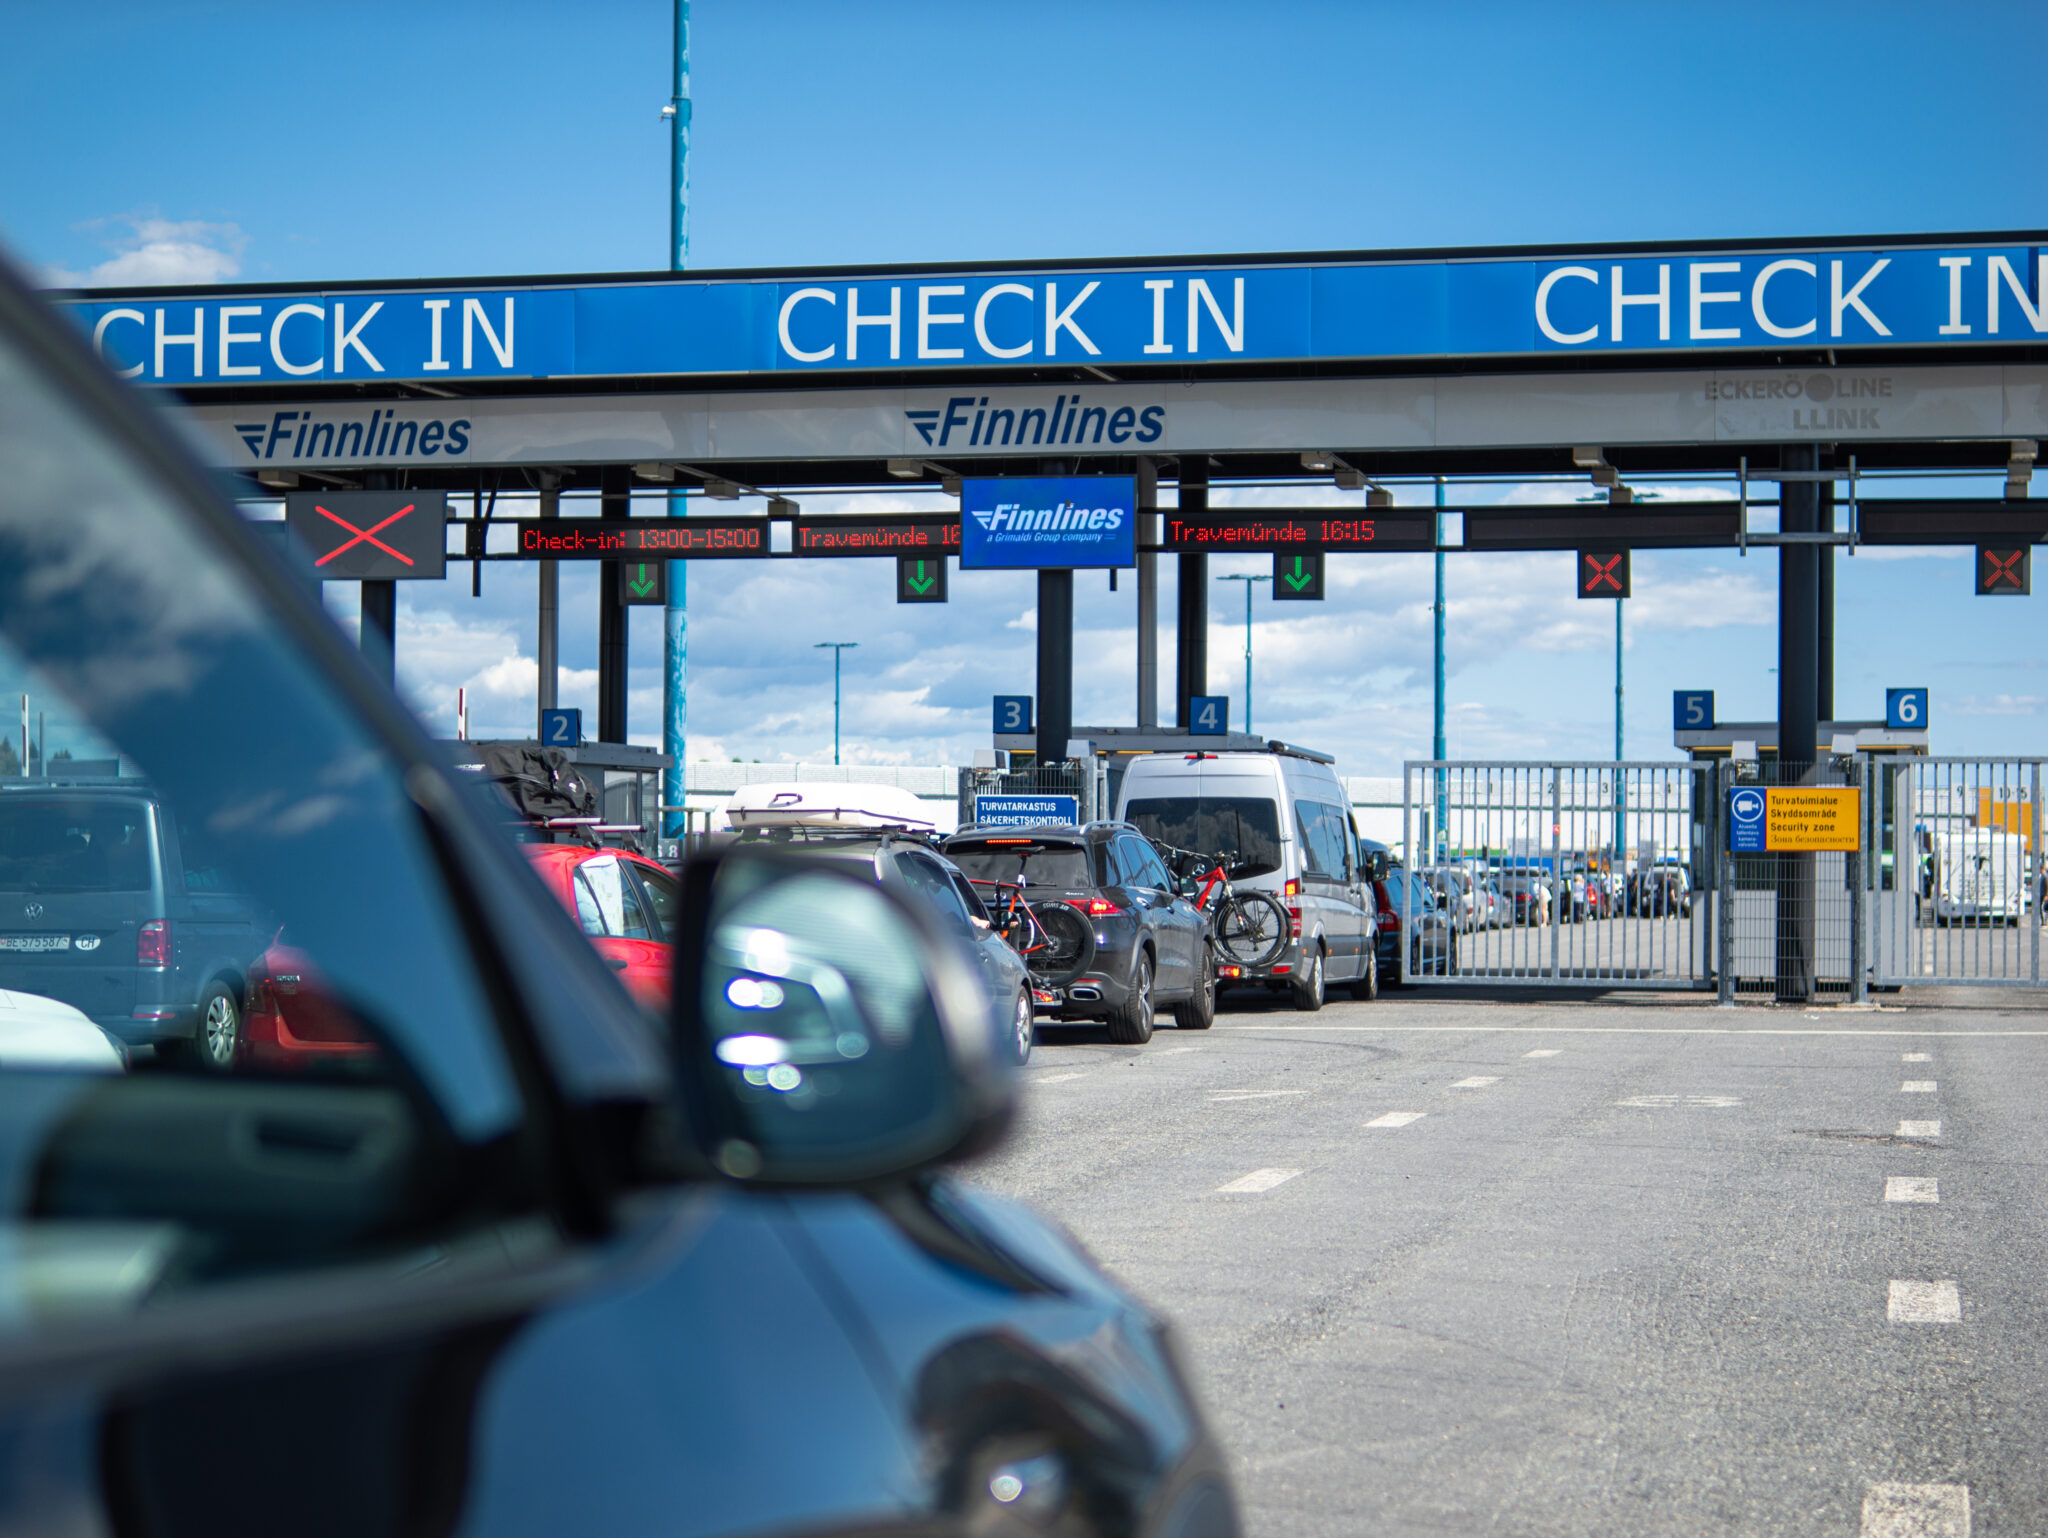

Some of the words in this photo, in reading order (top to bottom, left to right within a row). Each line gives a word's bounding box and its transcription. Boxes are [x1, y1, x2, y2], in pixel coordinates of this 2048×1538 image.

[1535, 259, 1893, 345] CHECK
[1939, 255, 2048, 335] IN
[778, 281, 1102, 362] CHECK
[1143, 277, 1244, 354] IN
[93, 301, 386, 380] CHECK
[423, 297, 514, 371] IN
[1704, 373, 1803, 400] ECKERÖ
[1836, 377, 1893, 398] LINE
[265, 409, 471, 459] Finnlines
[938, 395, 1165, 447] Finnlines
[989, 502, 1124, 532] Finnlines
[524, 529, 626, 549] Check-in:
[639, 528, 760, 549] 13:00-15:00
[799, 525, 928, 547] Travemünde
[995, 532, 1032, 542] Grimaldi
[1034, 532, 1060, 543] Group
[1062, 533, 1103, 543] company
[1170, 520, 1306, 542] Travemünde
[1320, 520, 1375, 542] 16:15
[1004, 701, 1021, 728] 3
[1198, 703, 1218, 729] 4
[1687, 696, 1704, 724] 5
[1898, 694, 1918, 722] 6
[552, 715, 569, 741] 2
[1602, 783, 1609, 794] 3
[980, 802, 1056, 811] TURVATARKASTUS
[980, 814, 1073, 825] SÄKERHETSKONTROLL
[1771, 809, 1837, 819] Skyddsområde
[1771, 822, 1809, 832] Security
[81, 936, 96, 948] CH
